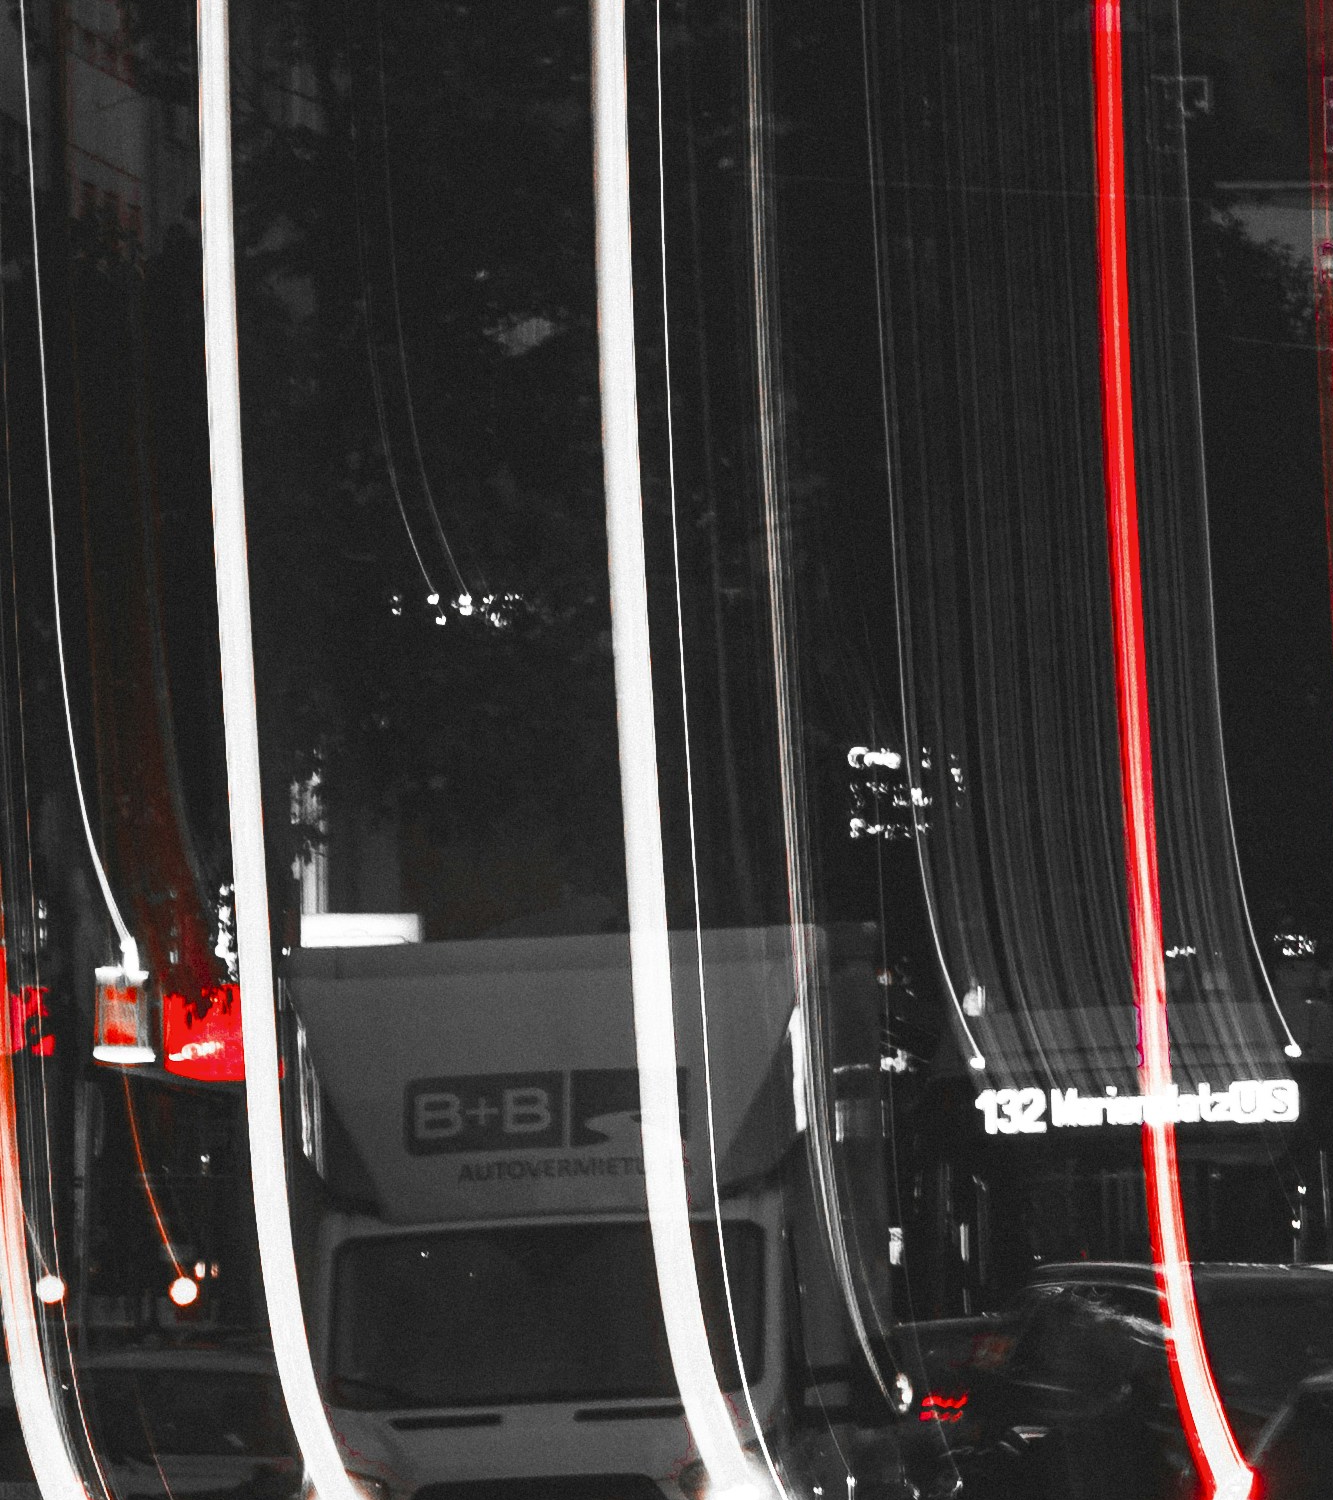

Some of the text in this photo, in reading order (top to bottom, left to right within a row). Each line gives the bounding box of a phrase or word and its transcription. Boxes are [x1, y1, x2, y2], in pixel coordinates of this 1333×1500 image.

[414, 1087, 551, 1140] B+B
[975, 1088, 1047, 1134] 132
[458, 1156, 693, 1183] AUTOVERMIETU
